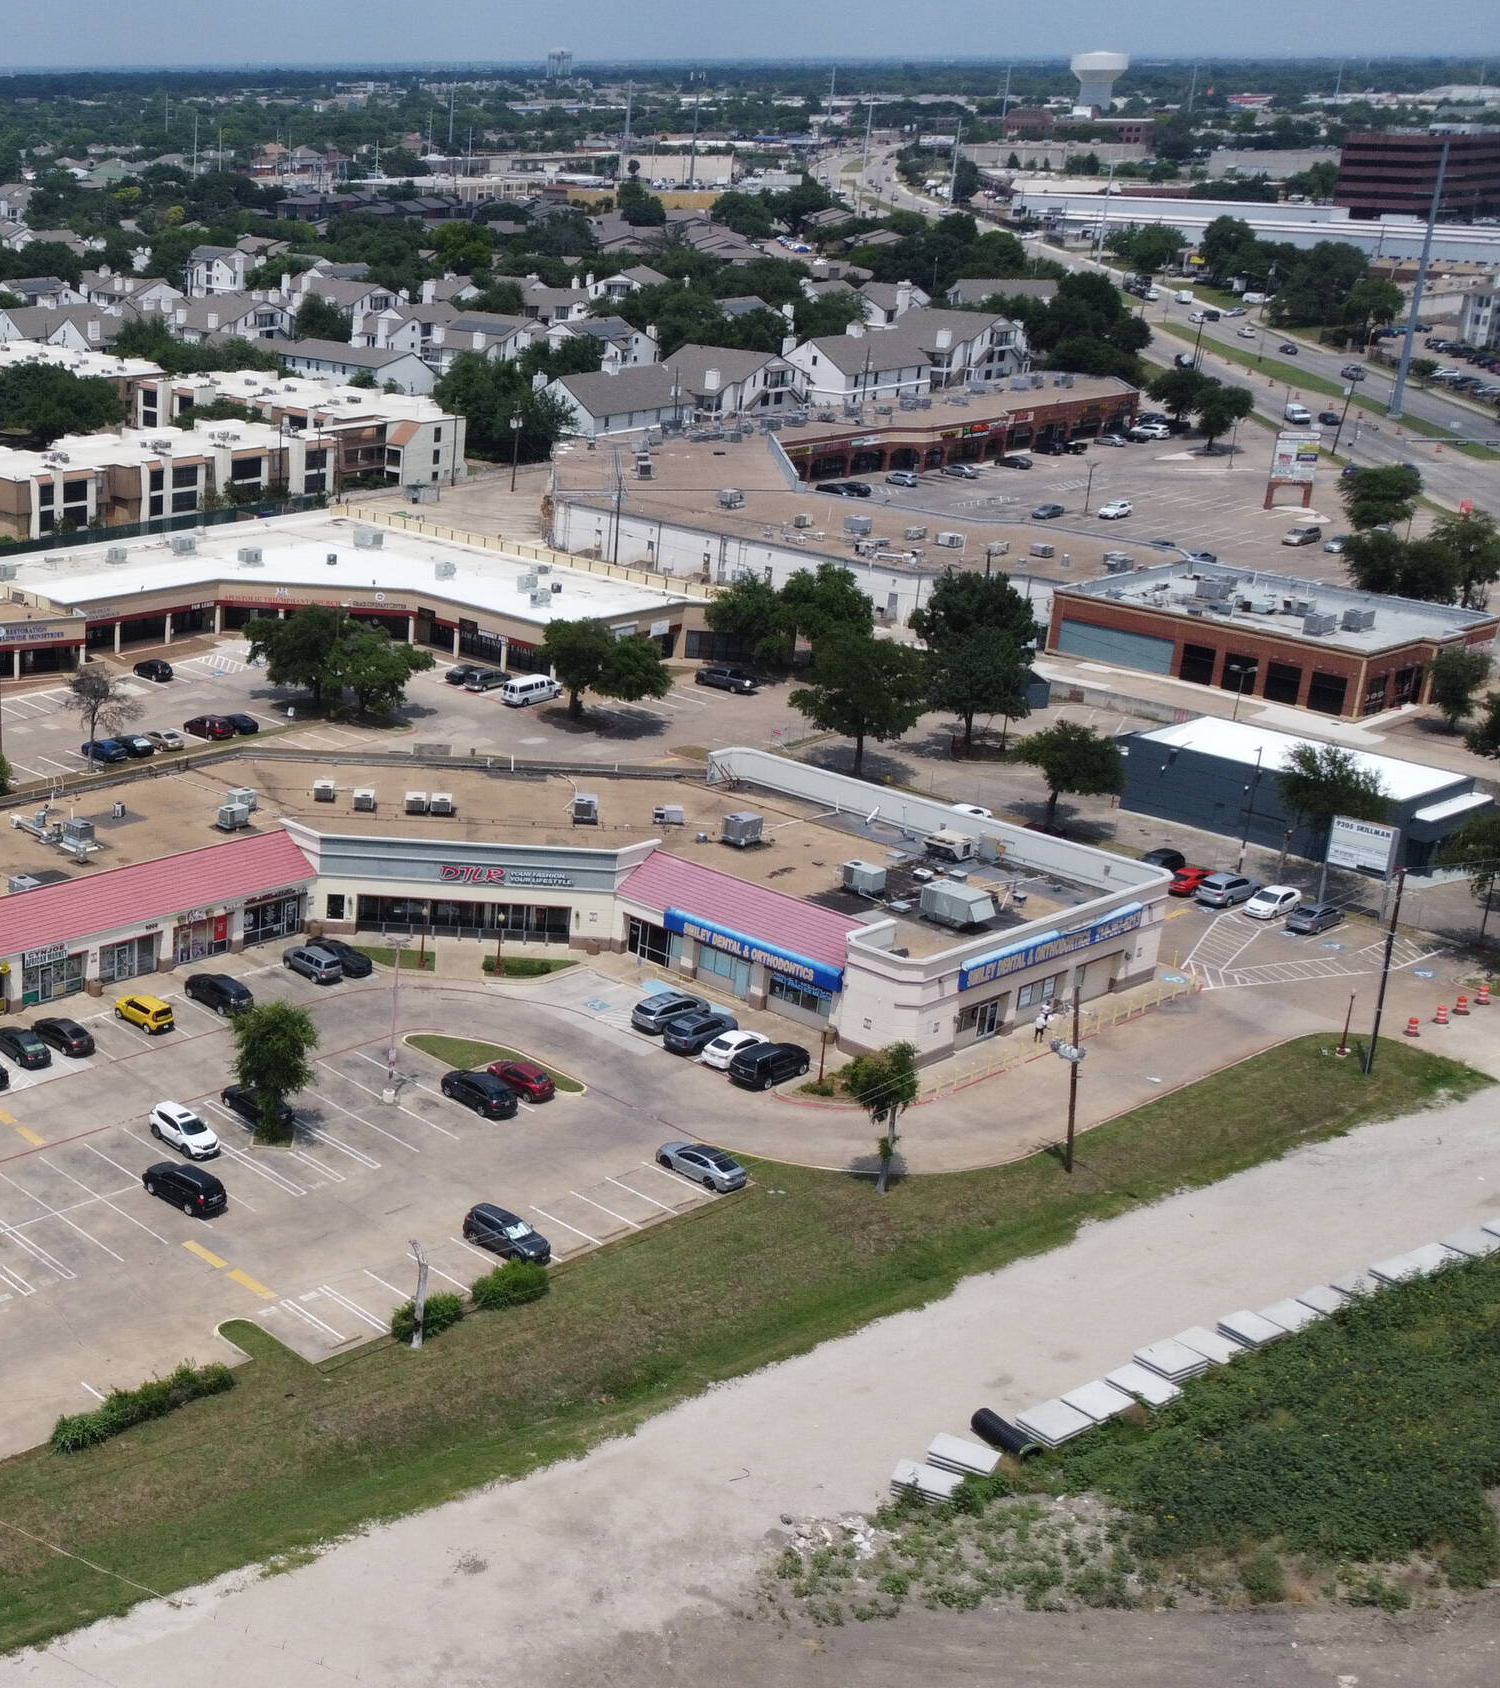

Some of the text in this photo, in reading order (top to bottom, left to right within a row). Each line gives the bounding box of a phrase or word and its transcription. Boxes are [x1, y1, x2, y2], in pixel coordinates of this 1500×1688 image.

[1356, 824, 1391, 838] SKILLMAN
[440, 864, 506, 884] DTLR
[683, 922, 815, 981] SMILEY DENTAL & ORTHODONTICS
[967, 964, 998, 987] SMILEY
[997, 951, 1026, 976] DENTAL
